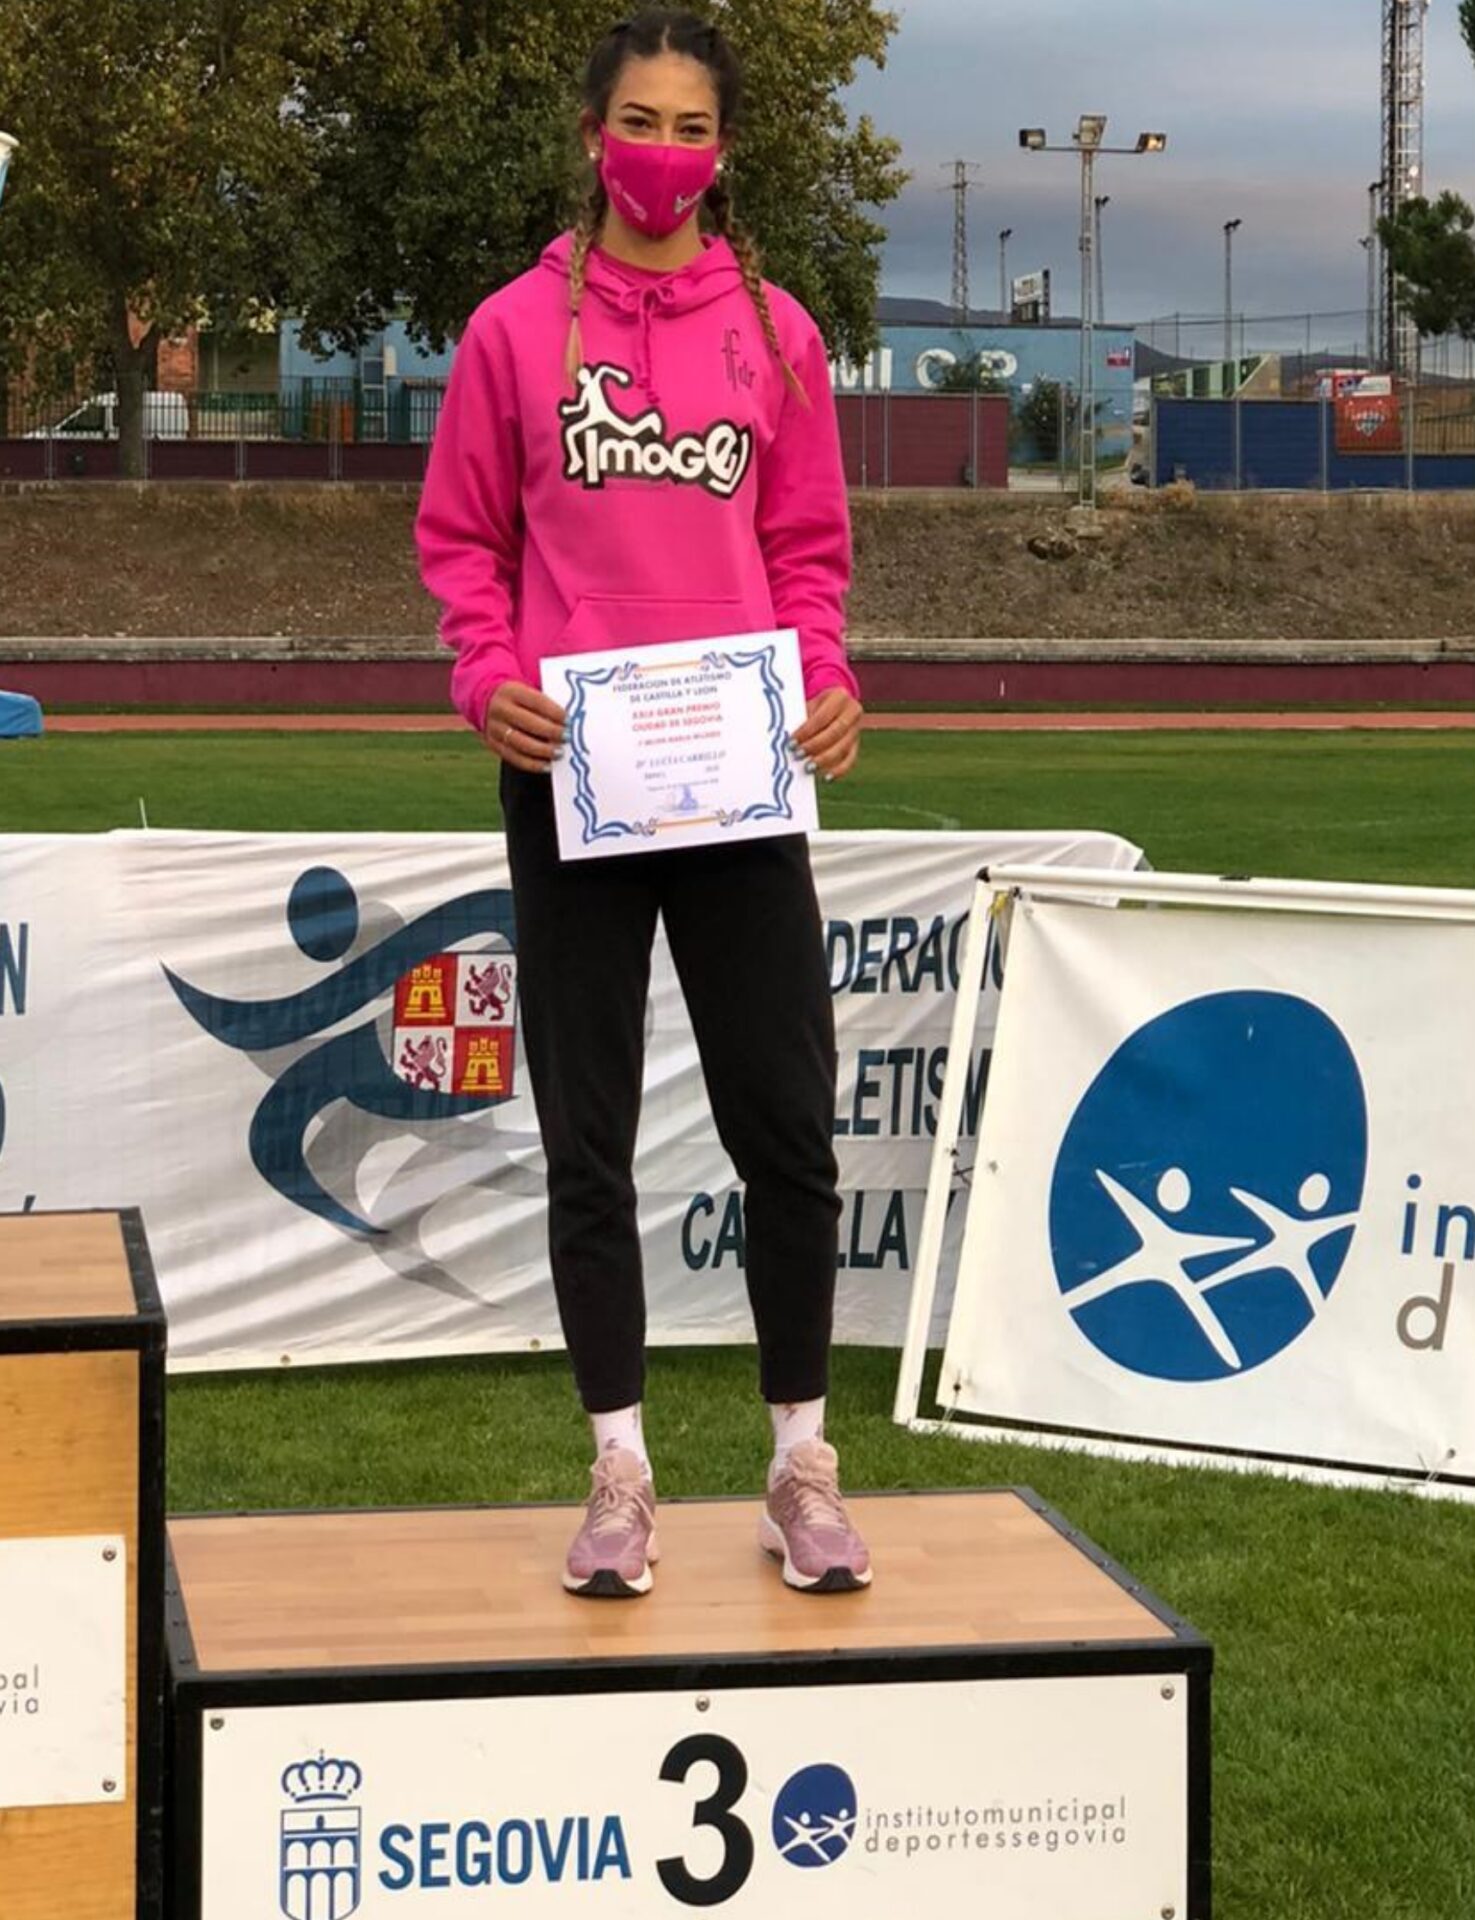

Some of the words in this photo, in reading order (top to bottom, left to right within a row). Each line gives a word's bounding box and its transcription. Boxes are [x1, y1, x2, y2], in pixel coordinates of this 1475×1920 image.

[643, 689, 683, 701] CASTILLA
[1401, 1174, 1475, 1260] in
[1396, 1262, 1455, 1352] d
[655, 1733, 754, 1907] 3
[864, 1823, 1126, 1859] deportessegovia
[866, 1796, 1126, 1829] institutomunicipal
[378, 1815, 632, 1890] SEGOVIA
